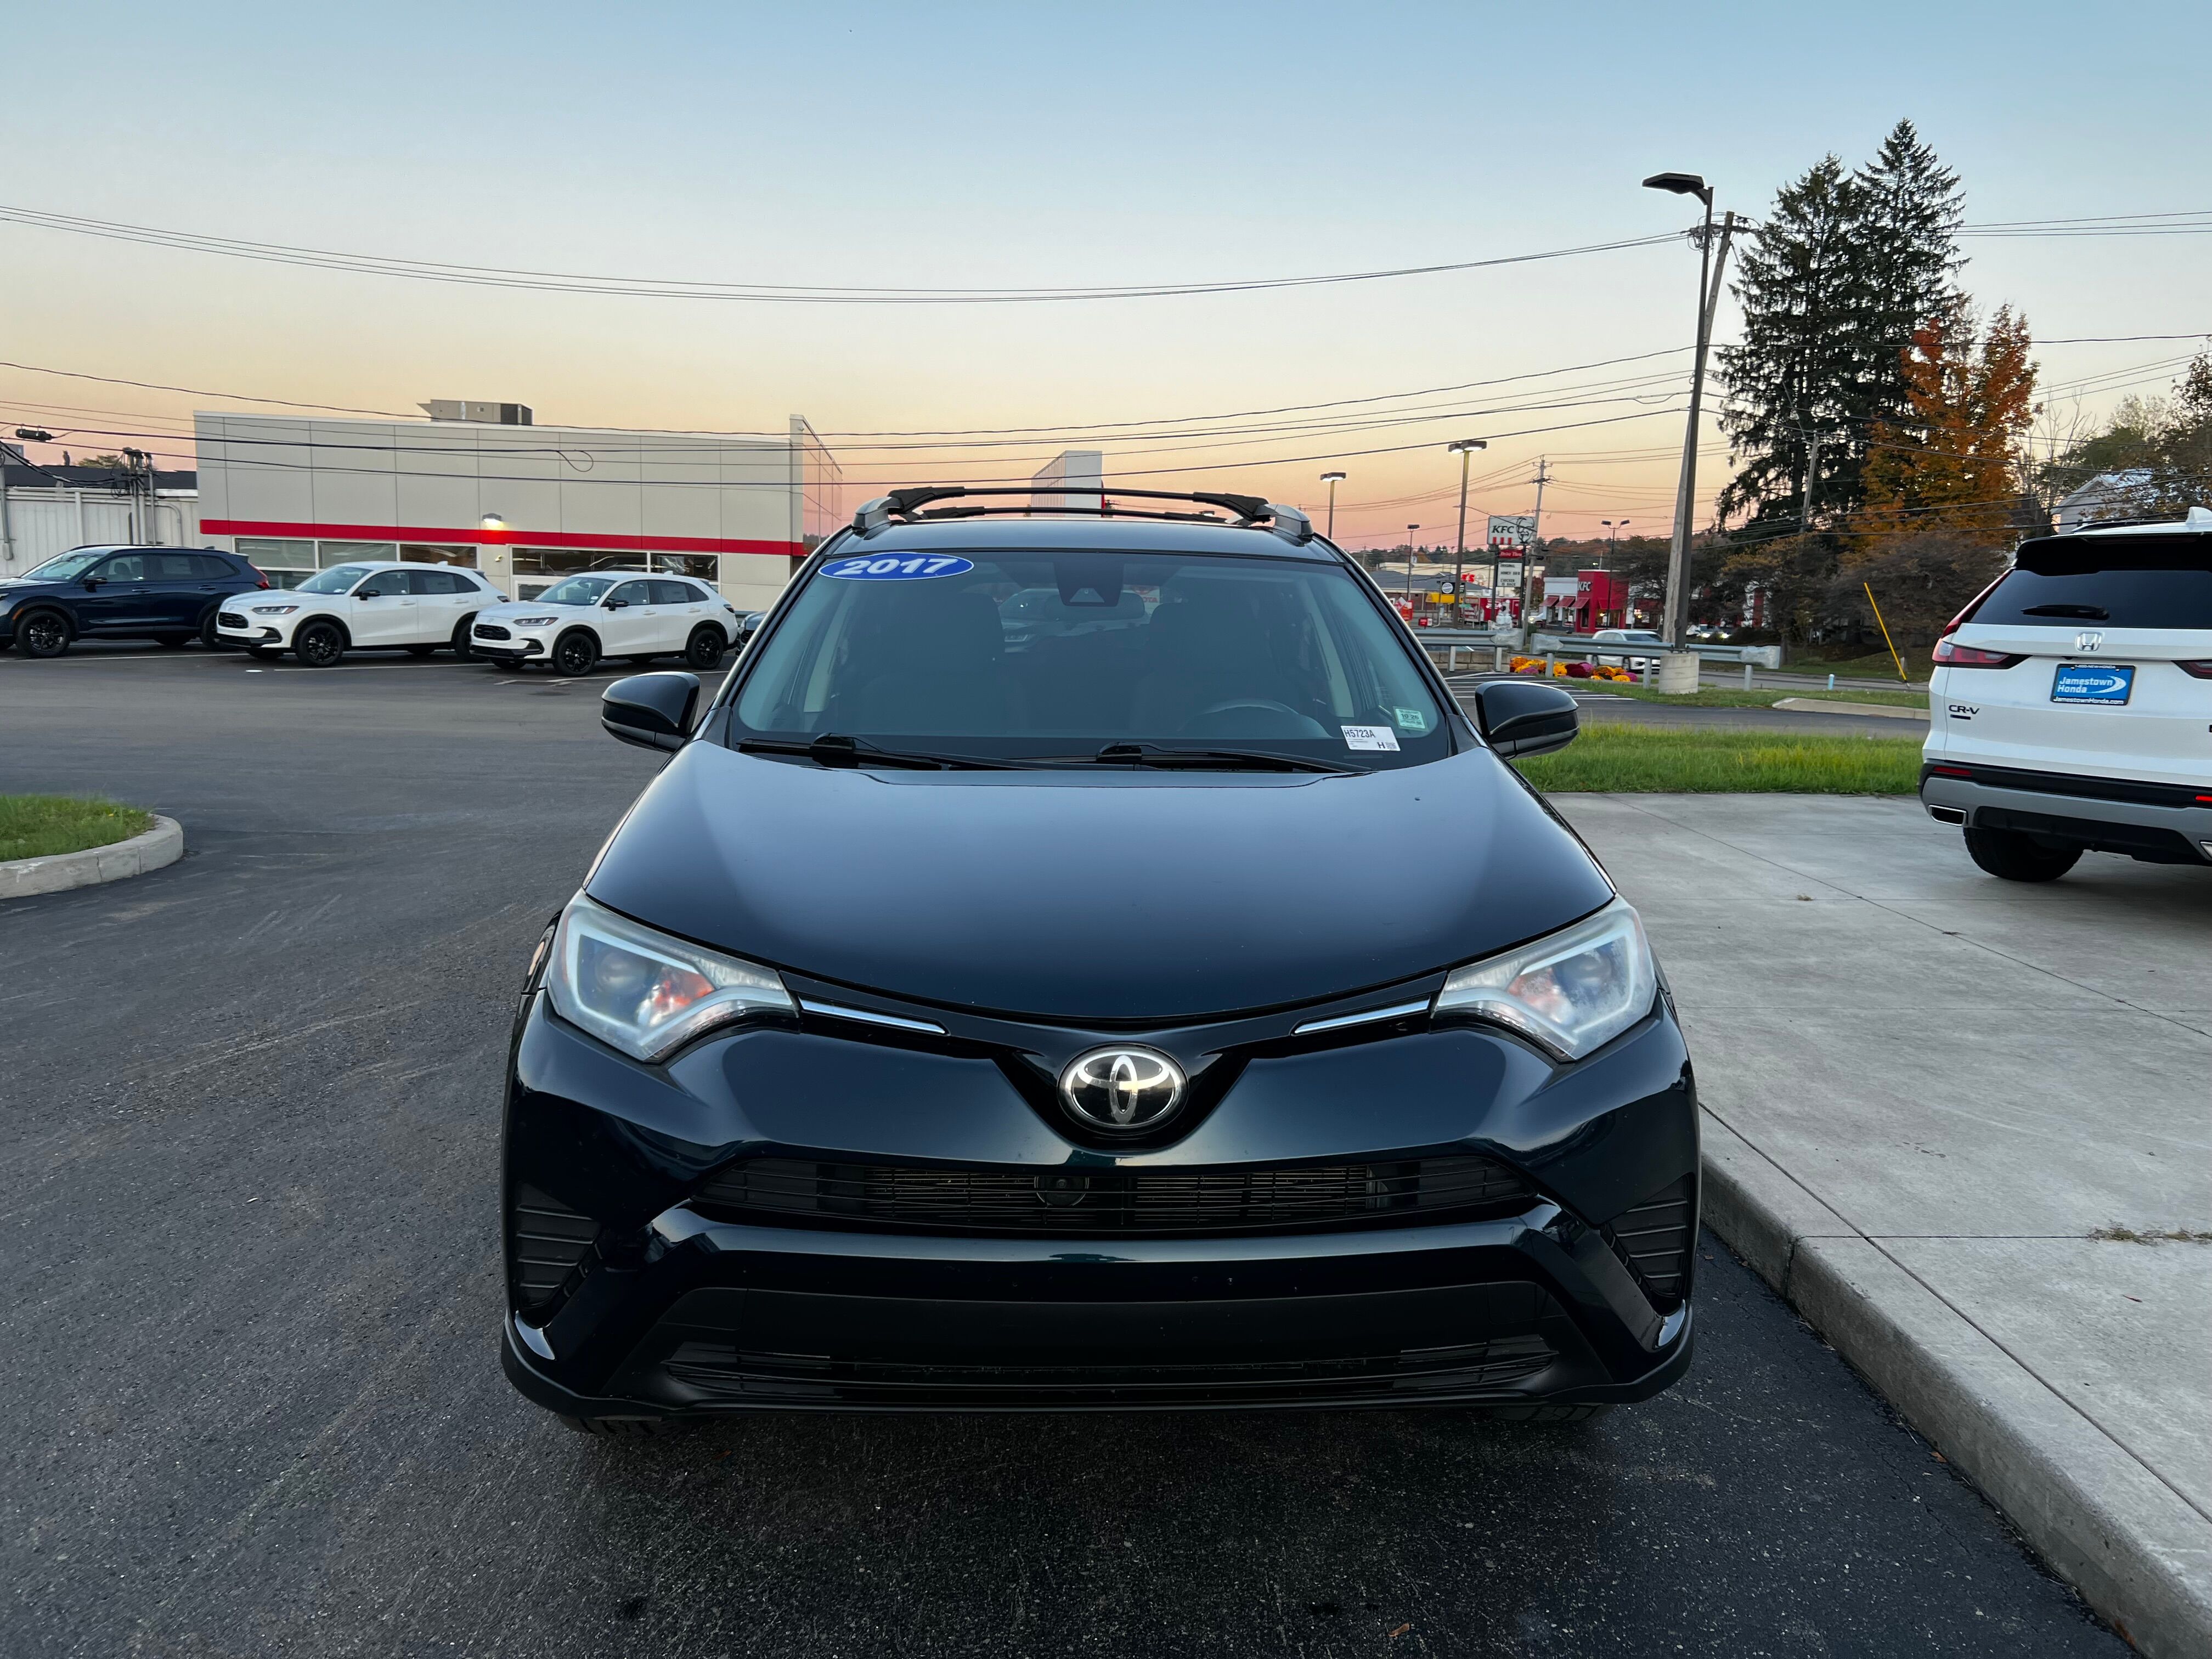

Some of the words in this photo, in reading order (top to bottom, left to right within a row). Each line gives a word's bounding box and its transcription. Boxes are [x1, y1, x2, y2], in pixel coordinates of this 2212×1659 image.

[1491, 525, 1515, 533] KFC
[833, 558, 959, 575] 2017
[1577, 582, 1592, 591] KFC
[2059, 676, 2113, 686] Jamestown
[2057, 685, 2087, 693] Honda
[1948, 704, 1980, 715] CR-V
[1344, 729, 1376, 738] H5723A
